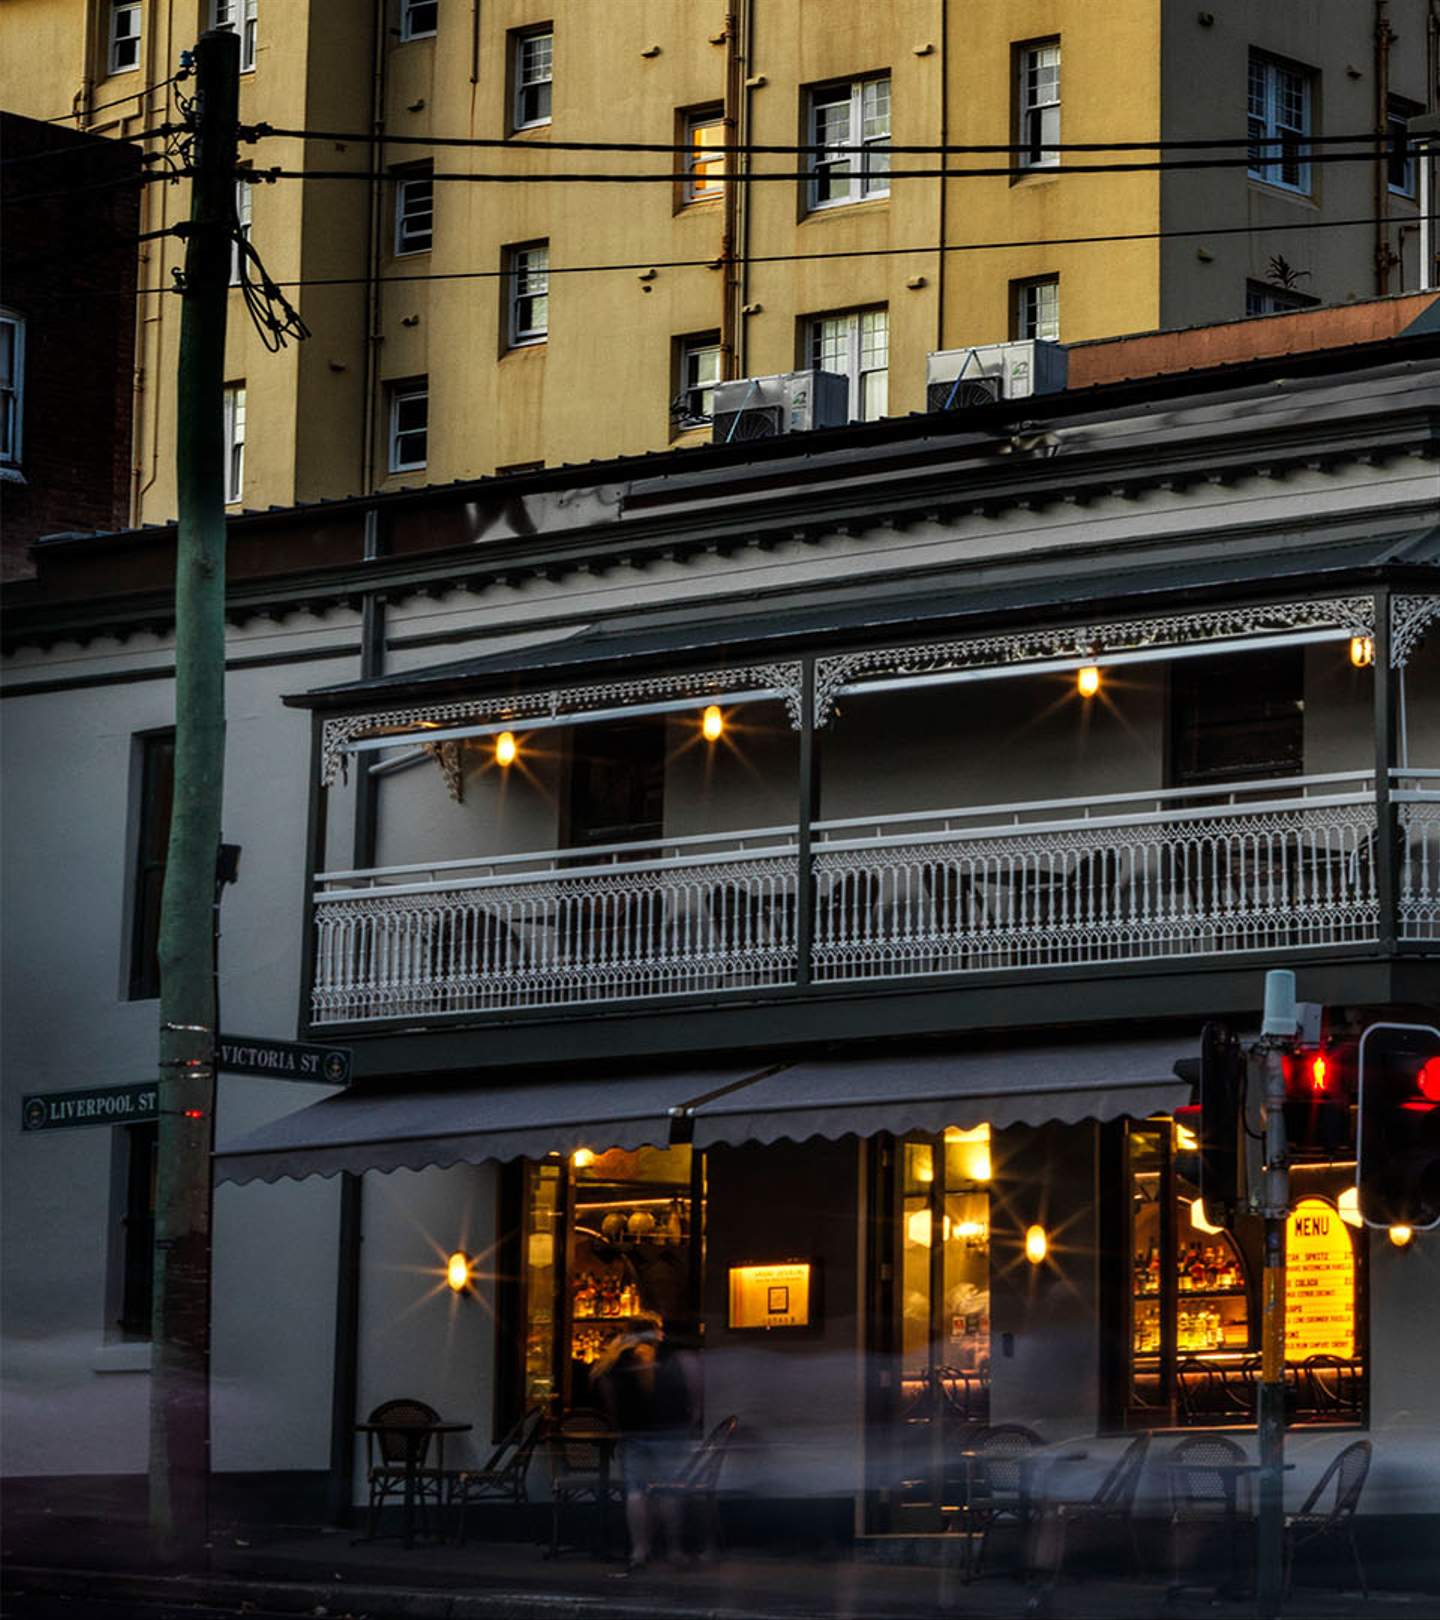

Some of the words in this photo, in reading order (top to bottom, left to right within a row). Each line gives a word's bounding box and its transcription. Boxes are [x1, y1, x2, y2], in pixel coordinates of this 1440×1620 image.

[222, 1045, 296, 1070] VICTORIA
[301, 1054, 319, 1072] ST
[50, 1094, 134, 1119] LIVERPOOL
[138, 1092, 156, 1111] ST
[1294, 1216, 1329, 1237] MENU
